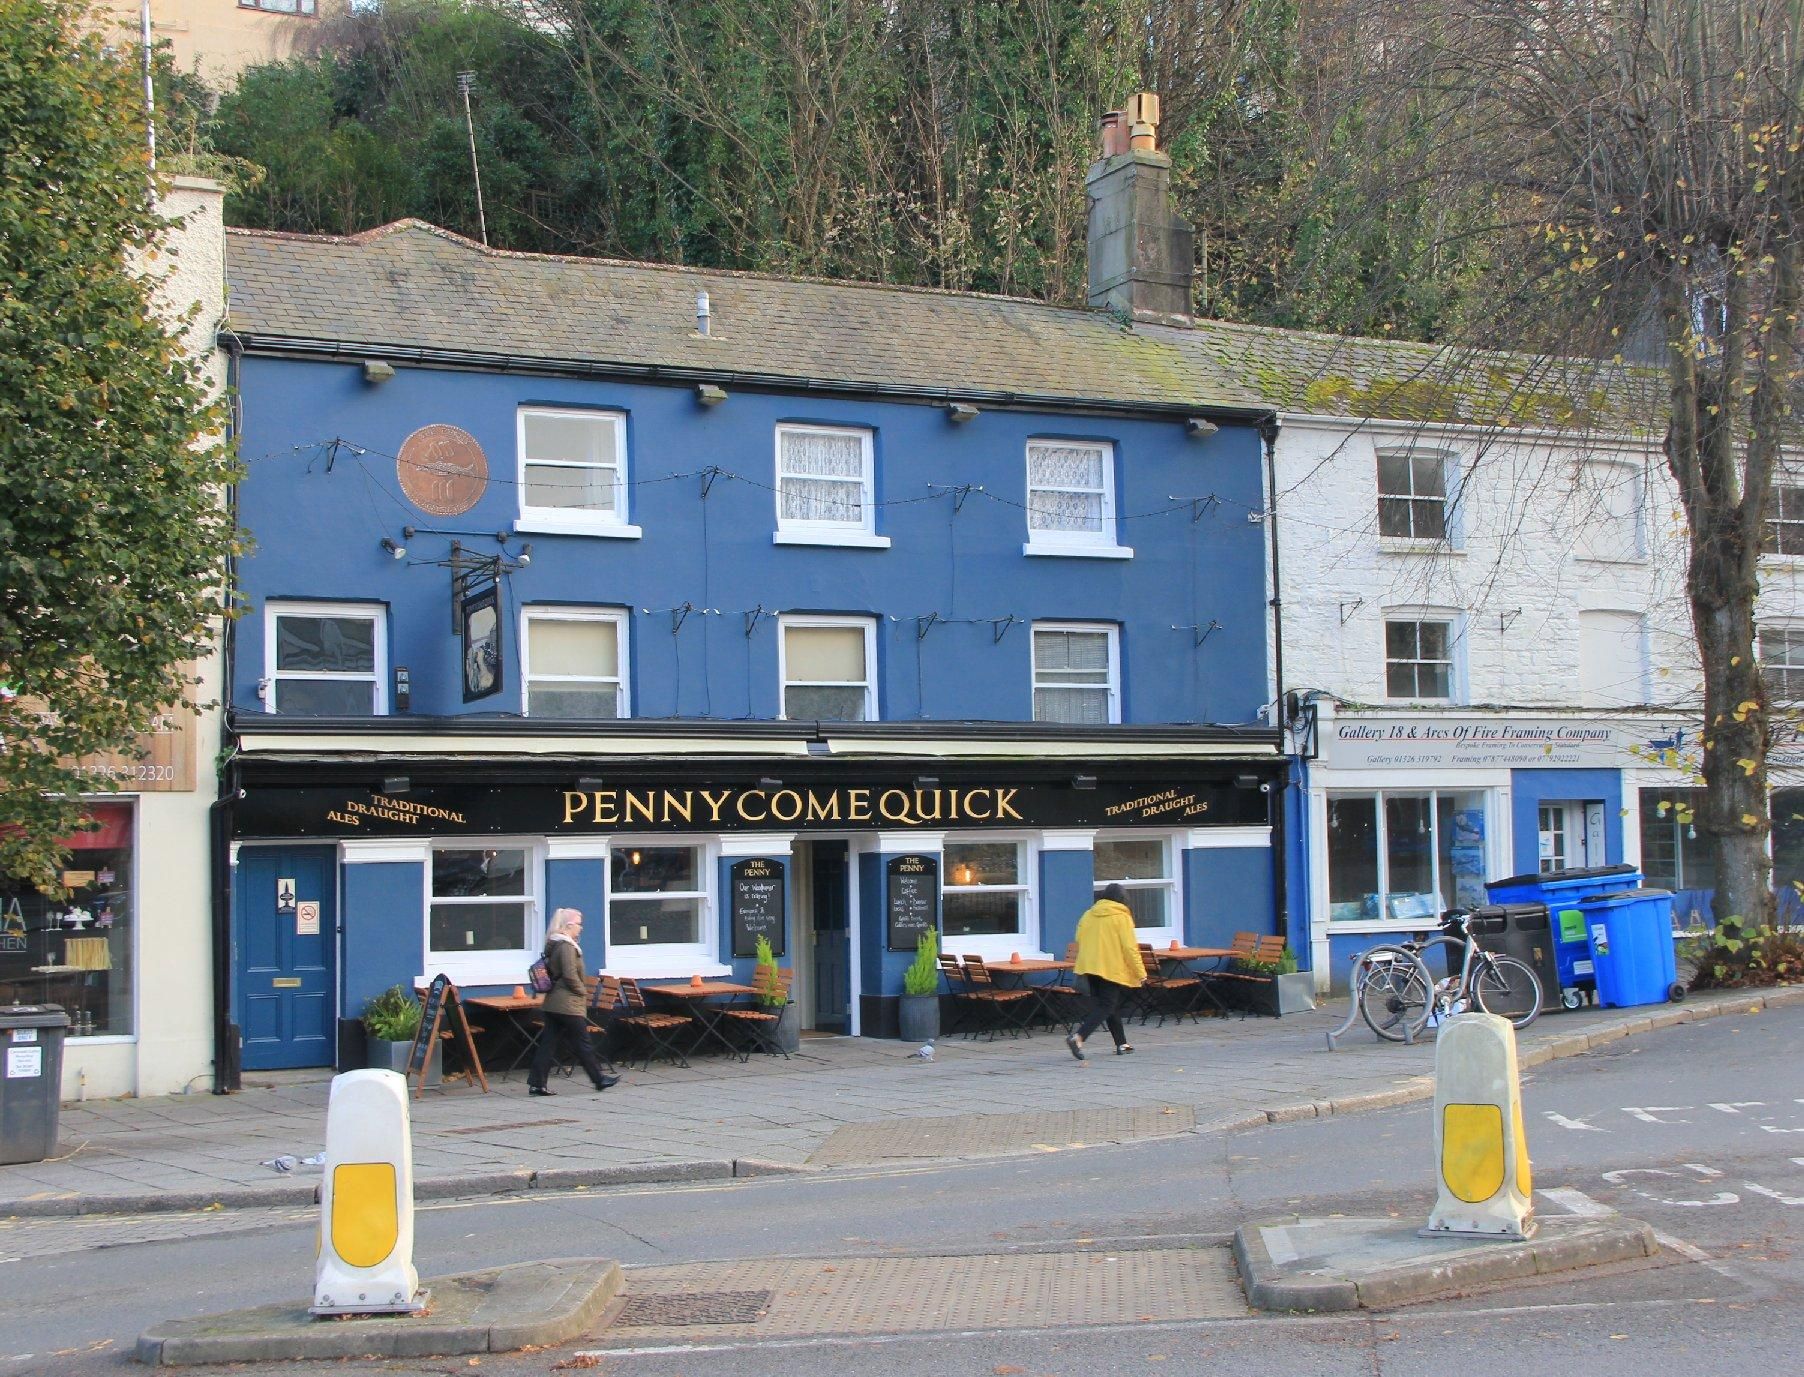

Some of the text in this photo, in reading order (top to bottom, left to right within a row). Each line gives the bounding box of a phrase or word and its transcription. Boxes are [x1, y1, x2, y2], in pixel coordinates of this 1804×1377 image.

[1339, 725, 1612, 744] Gallery 18 & Arcs Of Fire Framing Company
[1481, 742, 1506, 750] Framing
[1367, 755, 1392, 764] Gallery
[1452, 755, 1481, 764] Framing
[371, 794, 466, 824] TRADITIONAL
[562, 789, 1024, 824] PENNYCOMEQUICK
[1105, 789, 1177, 816] TRADITIONAL
[1142, 794, 1196, 817] DRAUGHT
[1183, 802, 1208, 817] ALES
[327, 810, 360, 826] ALES
[346, 801, 419, 825] DRAUGHT
[744, 868, 771, 877] PENNY
[900, 864, 924, 872] PENNY
[739, 882, 750, 892] Our
